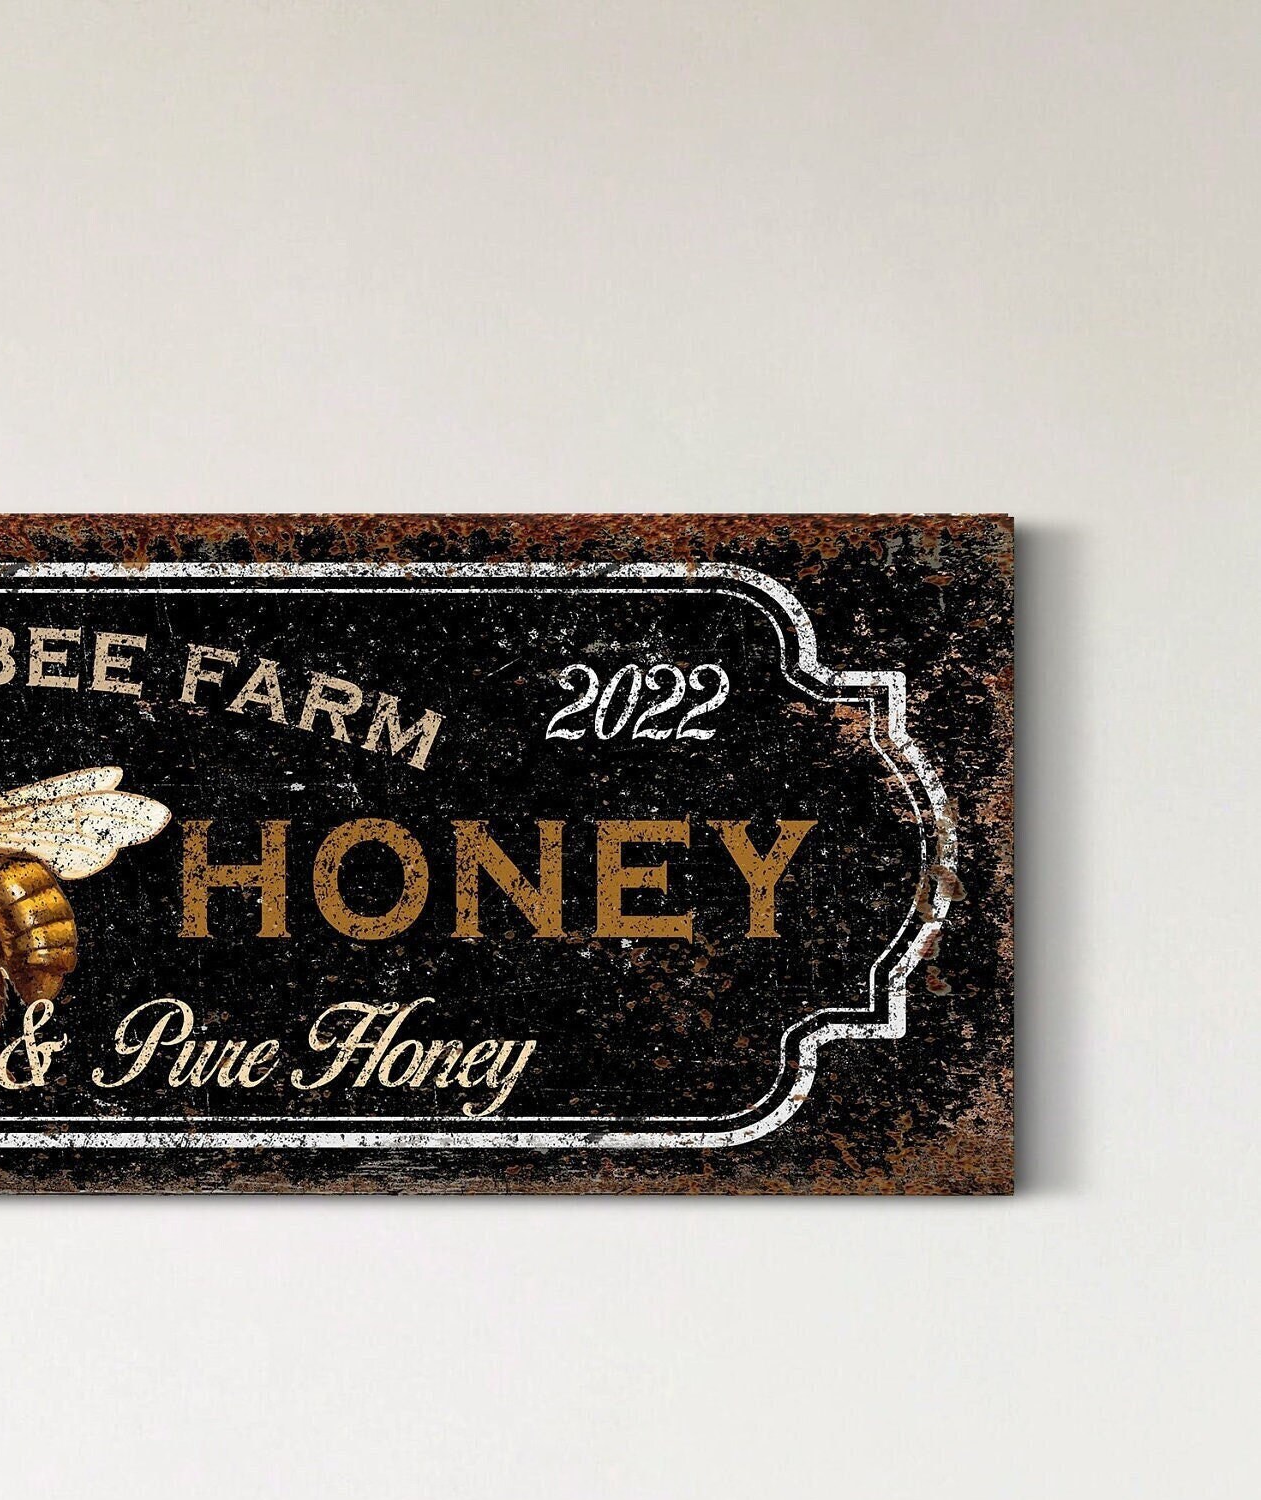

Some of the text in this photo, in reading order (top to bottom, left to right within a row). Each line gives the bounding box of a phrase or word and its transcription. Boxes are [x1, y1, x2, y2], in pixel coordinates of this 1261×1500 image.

[179, 642, 447, 772] FARM
[545, 662, 731, 742] 2022
[177, 813, 818, 944] HONEY
[92, 997, 280, 1090] Pure
[292, 996, 536, 1117] Honey
